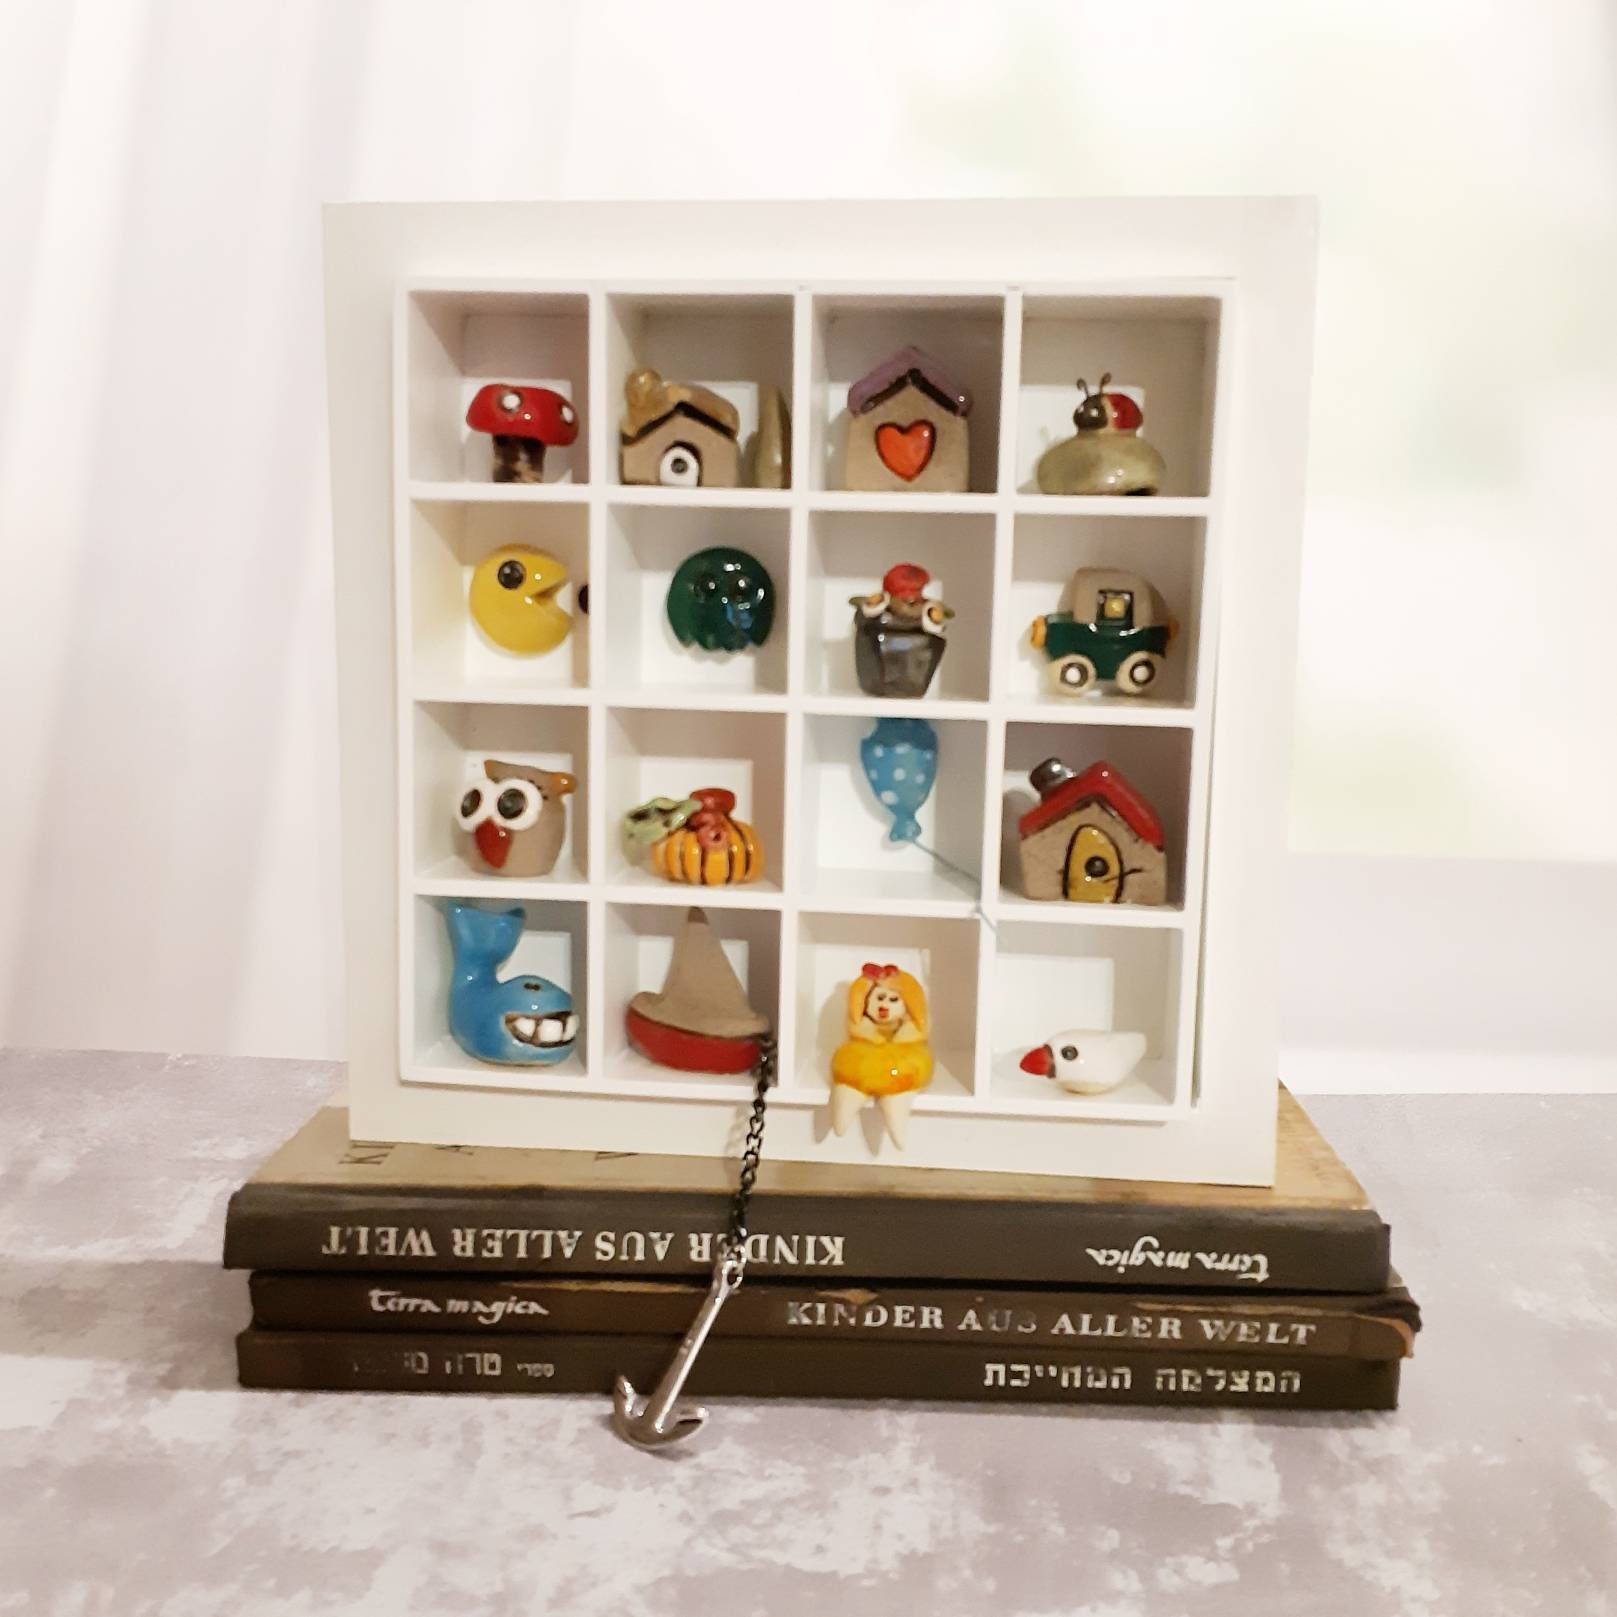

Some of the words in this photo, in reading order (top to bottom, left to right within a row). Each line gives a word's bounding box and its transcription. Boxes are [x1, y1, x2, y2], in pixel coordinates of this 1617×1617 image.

[321, 1224, 437, 1257] WELT
[451, 1227, 583, 1260] ALLER
[594, 1230, 675, 1262] AUS
[1085, 1235, 1192, 1274] magica
[446, 1295, 550, 1325] magica
[786, 1301, 945, 1330] KINDER
[957, 1308, 1038, 1335] AUS
[1050, 1313, 1183, 1341] ALLER
[1197, 1318, 1318, 1346] WELT
[983, 1362, 1133, 1390] המחייכת
[1155, 1367, 1302, 1394] המצלמה
